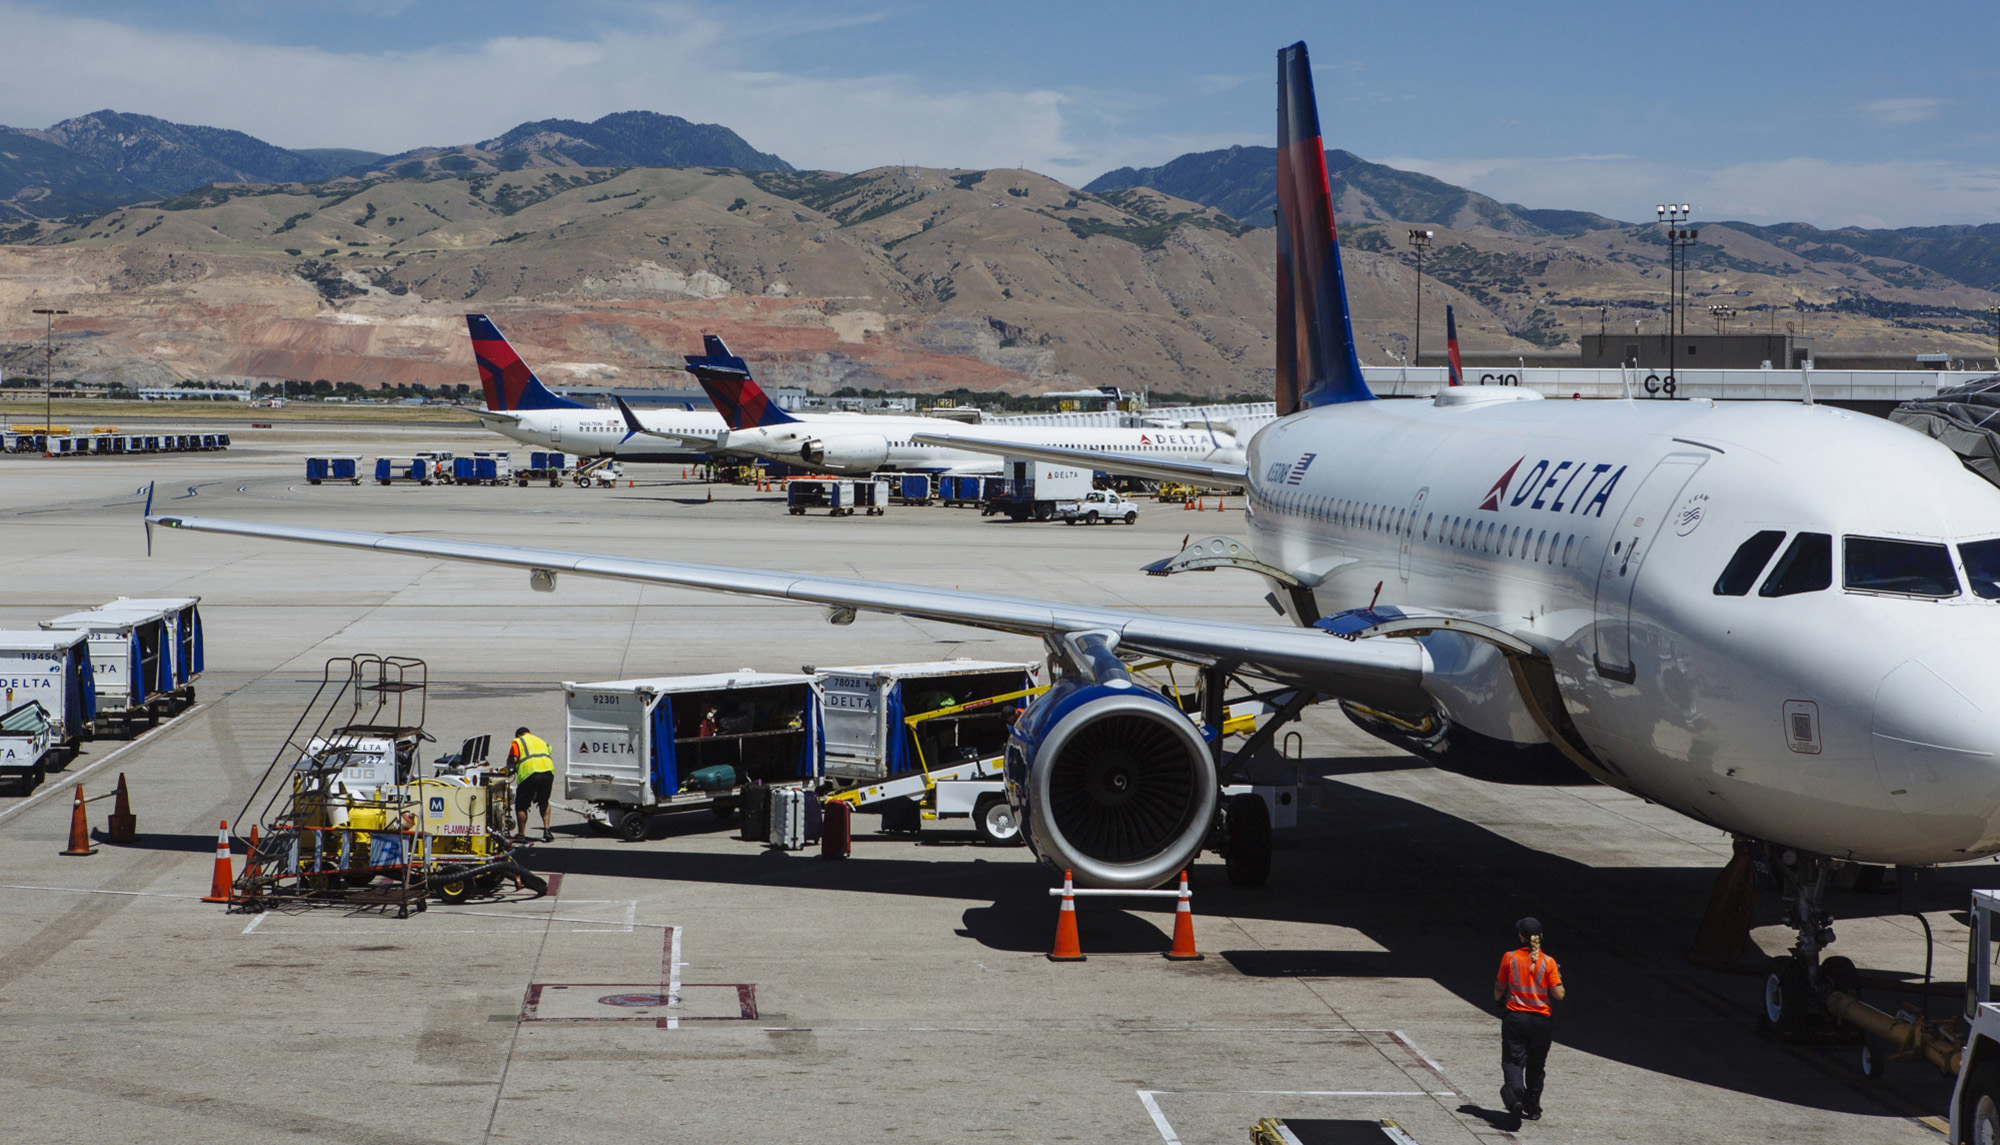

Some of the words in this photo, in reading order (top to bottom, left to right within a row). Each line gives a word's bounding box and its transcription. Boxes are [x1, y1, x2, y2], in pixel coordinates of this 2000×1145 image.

[1644, 374, 1677, 394] C8
[1155, 434, 1210, 445] DELTA
[1054, 471, 1078, 479] DELTA
[1510, 459, 1628, 518] DELTA
[21, 653, 58, 661] 113456
[91, 664, 117, 673] LTA
[0, 679, 51, 688] DELTA
[834, 678, 861, 688] 78028
[593, 695, 620, 704] 92301
[831, 696, 872, 709] DELTA
[592, 742, 635, 754] DELTA
[443, 824, 481, 835] FLAMMABLE
